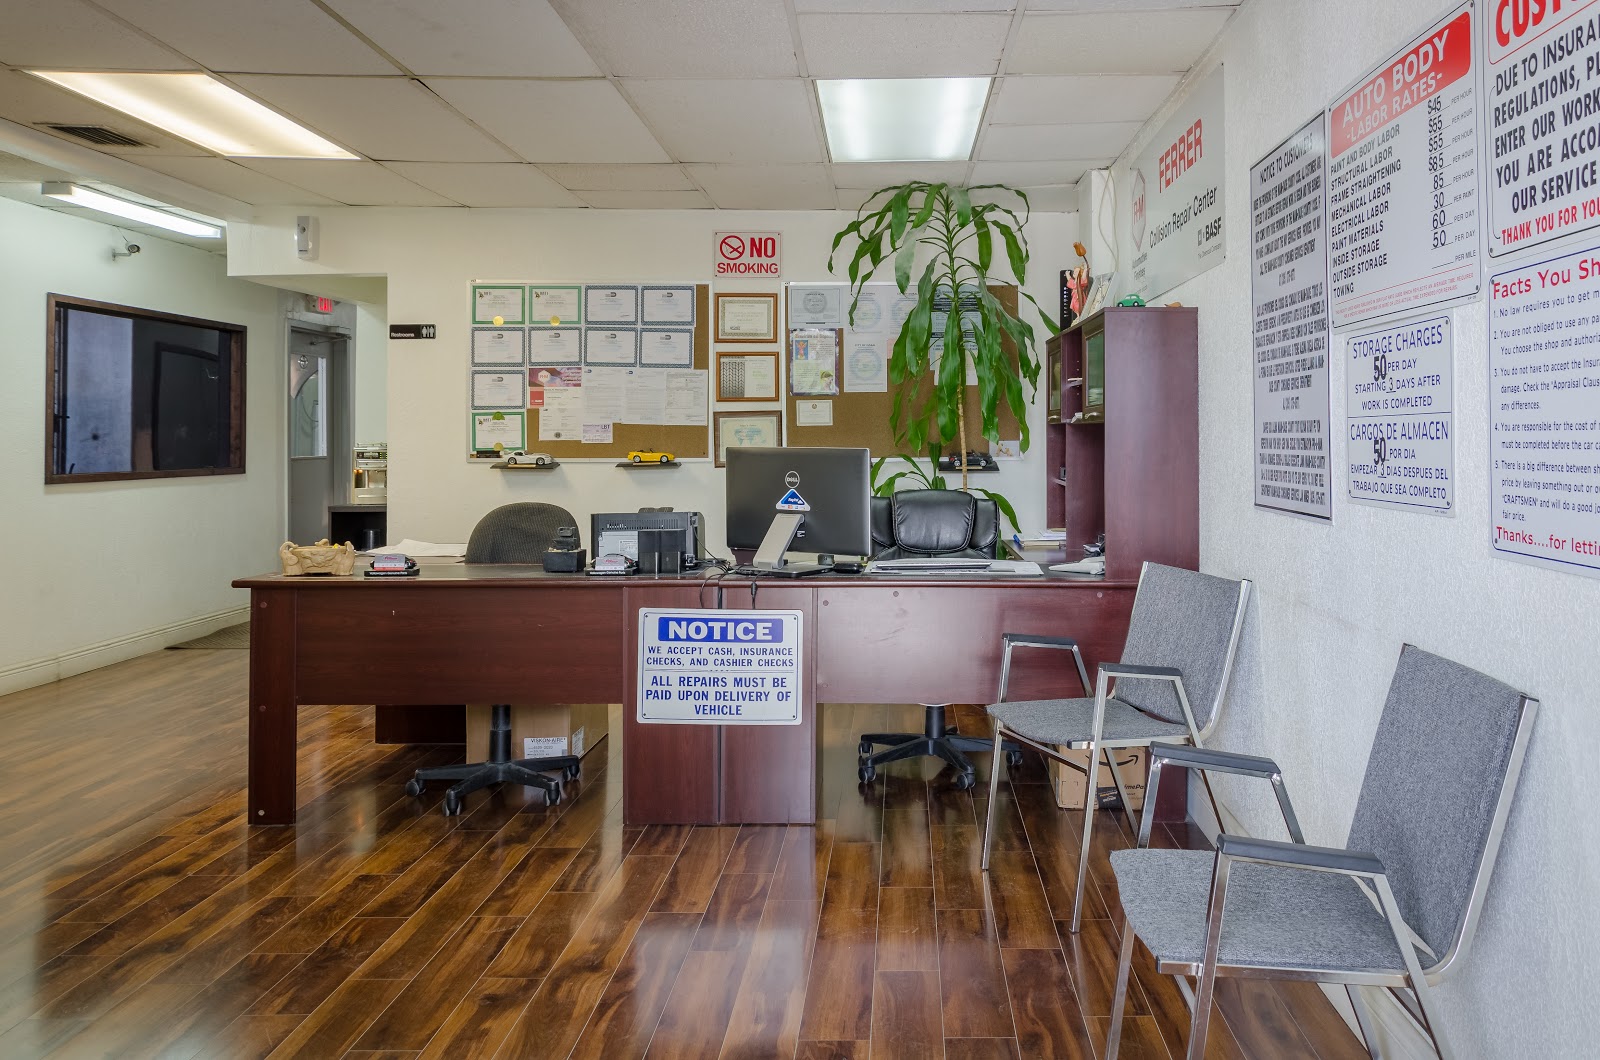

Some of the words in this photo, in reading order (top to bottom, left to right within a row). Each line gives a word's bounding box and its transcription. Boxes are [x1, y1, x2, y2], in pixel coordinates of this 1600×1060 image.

[1496, 63, 1518, 96] DUE
[1521, 53, 1538, 81] TO
[1543, 13, 1600, 70] INSURA
[1343, 77, 1386, 128] AUTO
[1393, 29, 1449, 92] BODY
[1494, 65, 1580, 128] REGULATIONS,
[1331, 158, 1345, 176] PAINT
[1347, 150, 1358, 165] AND
[1359, 138, 1375, 158] BODY
[1378, 124, 1400, 147] LABOR
[1428, 95, 1442, 114] $45
[1451, 95, 1460, 104] PER
[1460, 87, 1472, 100] HOUR
[1495, 125, 1526, 158] ENTER
[1532, 111, 1556, 140] OUR
[1562, 87, 1600, 127] WORK
[1159, 119, 1202, 193] FERRER
[1276, 156, 1283, 174] TO
[1331, 187, 1349, 207] FRAME
[1351, 159, 1401, 196] STRAIGHTENING
[1429, 132, 1443, 152] $55
[1452, 134, 1460, 144] PER
[1461, 127, 1473, 140] HOUR
[1331, 161, 1368, 191] STRUCTURAL
[1370, 146, 1393, 168] LABOR
[1496, 159, 1519, 188] YOU
[1527, 145, 1552, 176] ARE
[1561, 122, 1600, 162] ACCO
[1331, 194, 1367, 222] MECHANICAL
[1369, 182, 1391, 203] LABOR
[1429, 152, 1443, 171] $85
[1512, 185, 1537, 213] OUR
[1541, 160, 1597, 203] SERVICE
[1150, 220, 1171, 248] Collision
[1173, 202, 1191, 232] Repair
[1193, 186, 1217, 217] Center
[1332, 212, 1365, 238] ELECTRICAL
[1367, 200, 1389, 221] LABOR
[1433, 172, 1444, 190] 85
[1453, 174, 1461, 183] PER
[1462, 168, 1474, 180] HOUR
[1206, 216, 1221, 241] BASF
[1332, 237, 1347, 253] PAINT
[1349, 220, 1384, 246] MATERIALS
[1433, 192, 1444, 210] 30
[1502, 221, 1532, 245] THANK
[1536, 213, 1554, 234] YOU
[1558, 205, 1577, 227] FOR
[750, 237, 776, 258] NO
[1333, 252, 1349, 268] INSIDE
[1351, 239, 1380, 261] STORAGE
[1432, 209, 1445, 229] 60
[1454, 213, 1463, 223] PER
[1465, 209, 1475, 219] DAY
[717, 262, 779, 274] SMOKING
[1333, 265, 1356, 283] OUTSIDE
[1358, 253, 1388, 274] STORAGE
[1432, 229, 1446, 248] 50
[1454, 233, 1464, 243] PER
[1465, 229, 1475, 239] DAY
[1334, 282, 1354, 298] TOWING
[1455, 253, 1464, 262] PER
[1465, 249, 1476, 258] MILE
[1493, 278, 1531, 300] Facts
[1537, 269, 1571, 288] You
[1500, 308, 1508, 317] No
[1511, 305, 1521, 315] law
[1523, 301, 1550, 313] requires
[1552, 298, 1565, 308] you
[1567, 295, 1575, 304] to
[1578, 291, 1590, 303] get
[1353, 336, 1393, 359] STORAGE
[1396, 325, 1443, 351] CHARGES
[1374, 354, 1387, 382] 50
[1388, 361, 1400, 372] PER
[1402, 358, 1417, 370] DAY
[1355, 381, 1386, 394] STARTING
[1388, 377, 1394, 391] 3
[1397, 378, 1415, 390] DAYS
[1418, 375, 1441, 388] AFTER
[1523, 382, 1540, 392] Check
[1362, 400, 1380, 411] WORK
[1383, 399, 1389, 410] IS
[1391, 396, 1433, 409] COMPLETED
[1350, 423, 1384, 441] CARGOS
[1387, 422, 1398, 440] DE
[1401, 421, 1449, 440] ALMACEN
[1374, 437, 1386, 465] 50
[1390, 448, 1402, 459] POR
[1404, 448, 1416, 459] DIA
[1351, 464, 1378, 475] EMPEZAR
[1381, 461, 1386, 476] 3
[1387, 466, 1402, 477] DIAS
[1403, 467, 1433, 479] DESPUES
[1435, 468, 1449, 480] DEL
[1353, 480, 1379, 493] TRABAJO
[1381, 482, 1393, 494] QUE
[1395, 484, 1407, 495] SEA
[1409, 485, 1447, 499] COMPLETO
[1540, 499, 1549, 508] and
[1563, 501, 1570, 510] do
[1578, 503, 1592, 512] good
[669, 621, 773, 640] NOTICE
[646, 657, 685, 667] CHECKS,
[690, 658, 708, 667] AND
[714, 659, 752, 667] CASHIER
[758, 659, 794, 667] CHECKS
[648, 646, 662, 654] WE
[667, 647, 703, 655] ACCEPT
[709, 647, 735, 657] CASH,
[740, 648, 793, 656] INSURANCE
[646, 690, 672, 700] PAID
[679, 690, 709, 701] UPON
[715, 691, 770, 702] DELIVERY
[777, 691, 792, 702] OF
[651, 676, 672, 687] ALL
[679, 676, 727, 688] REPAIRS
[734, 677, 766, 688] MUST
[773, 677, 787, 688] BE
[695, 705, 743, 716] VEHICLE
